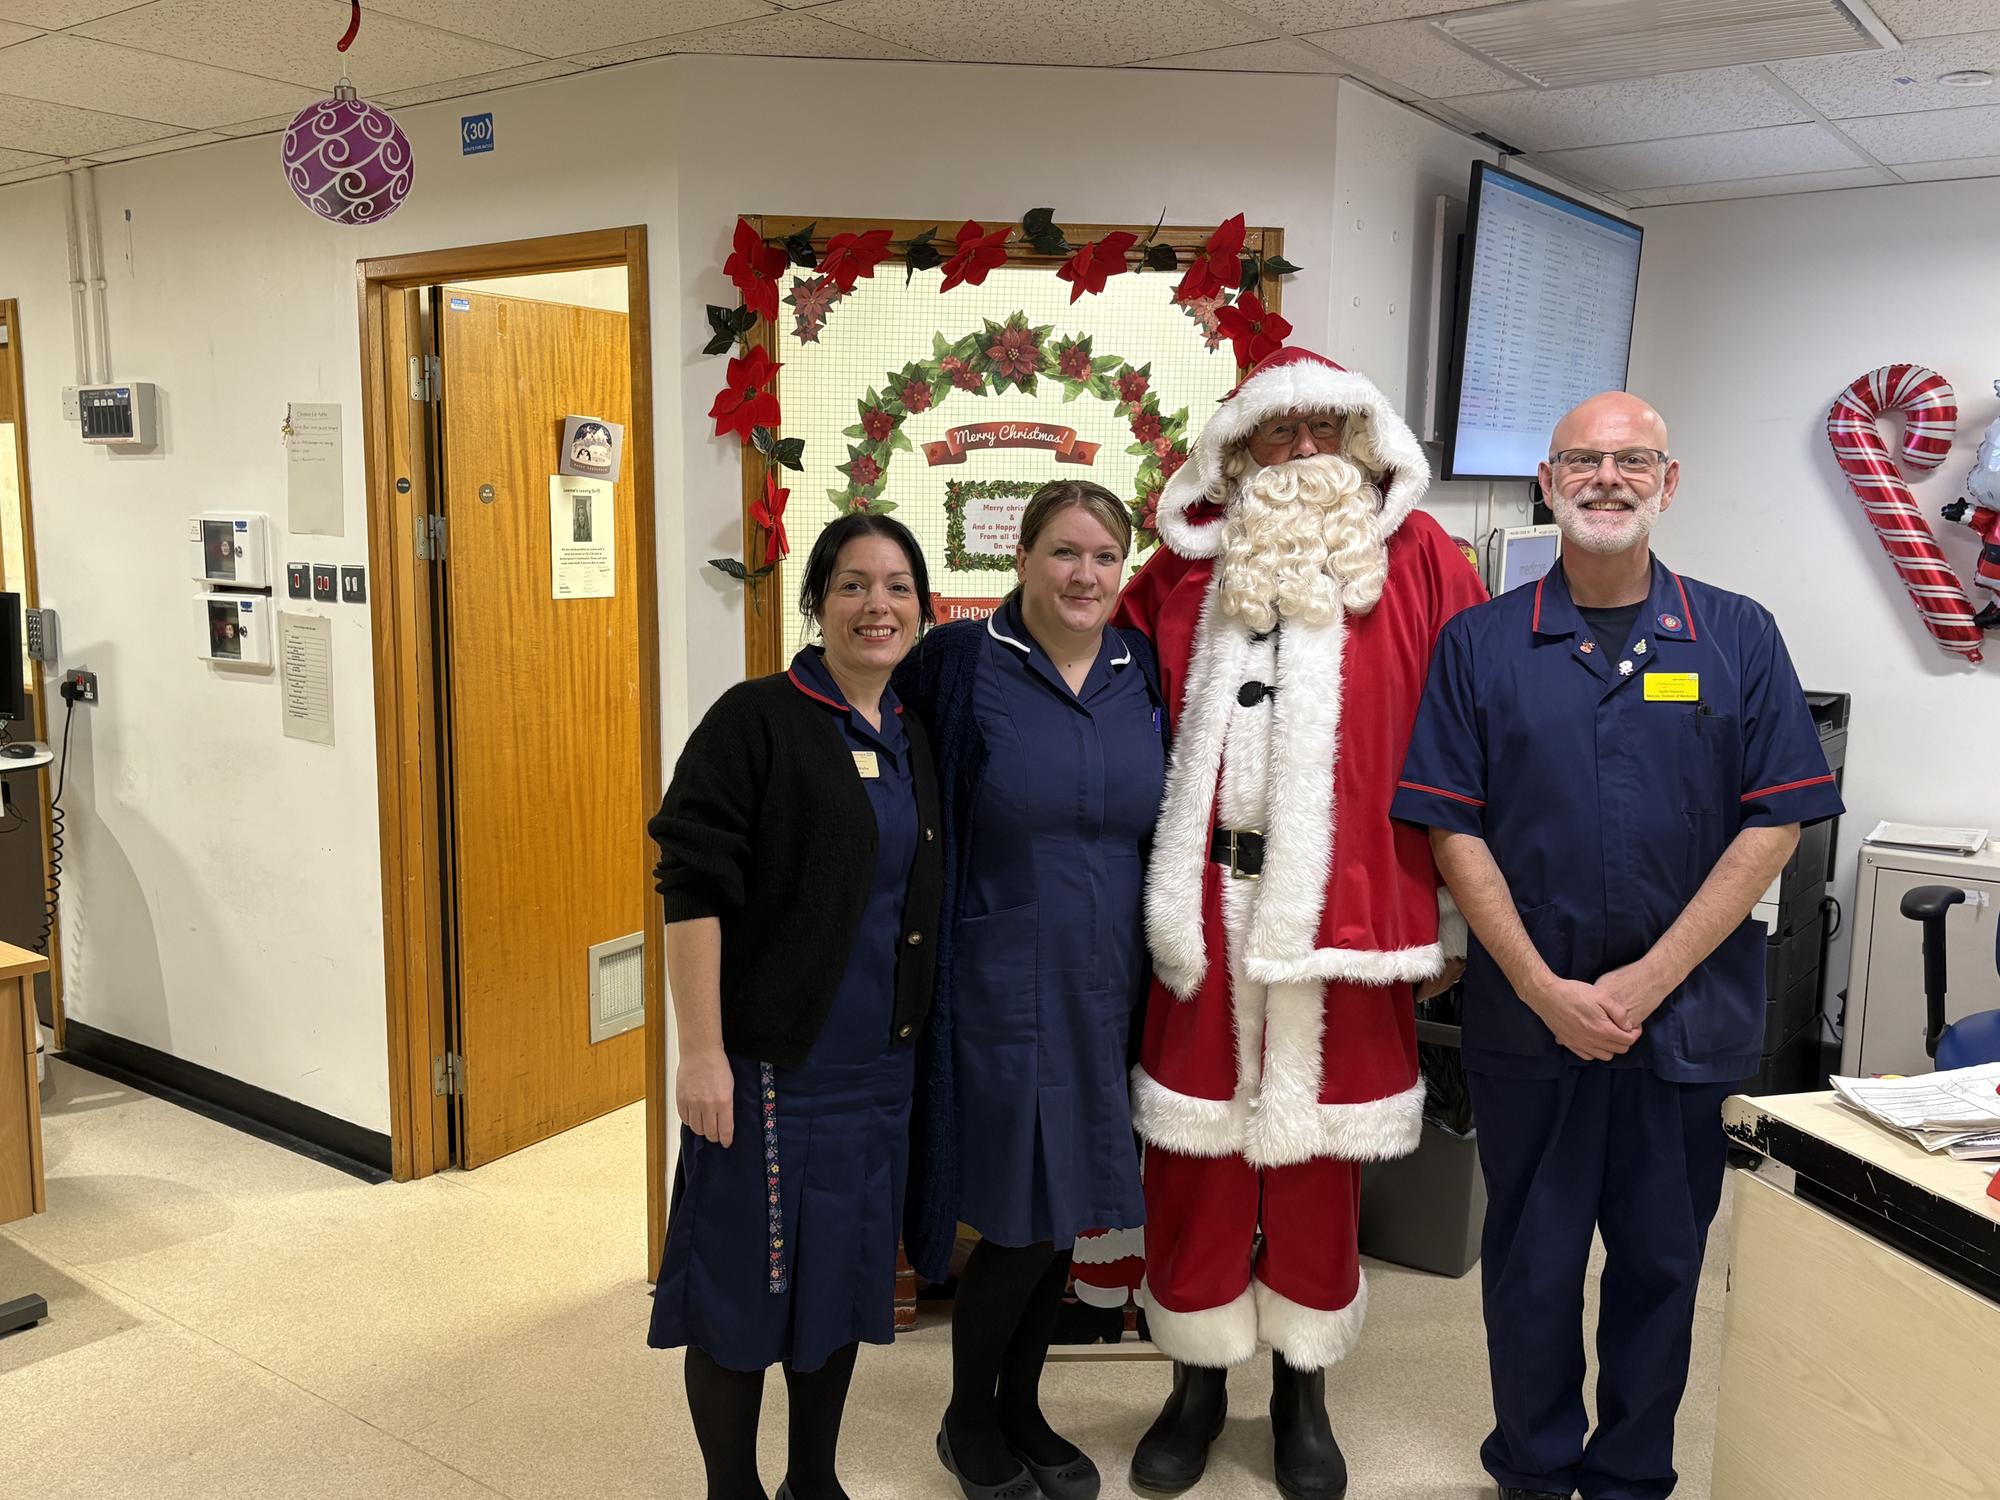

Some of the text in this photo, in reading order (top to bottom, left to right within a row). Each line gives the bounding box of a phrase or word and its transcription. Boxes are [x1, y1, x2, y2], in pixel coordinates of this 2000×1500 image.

[470, 121, 485, 140] 30
[953, 424, 1069, 447] Merry Christmas!
[983, 504, 1004, 513] Merry
[995, 523, 1017, 532] Happy
[980, 532, 998, 540] From
[993, 542, 1003, 550] On
